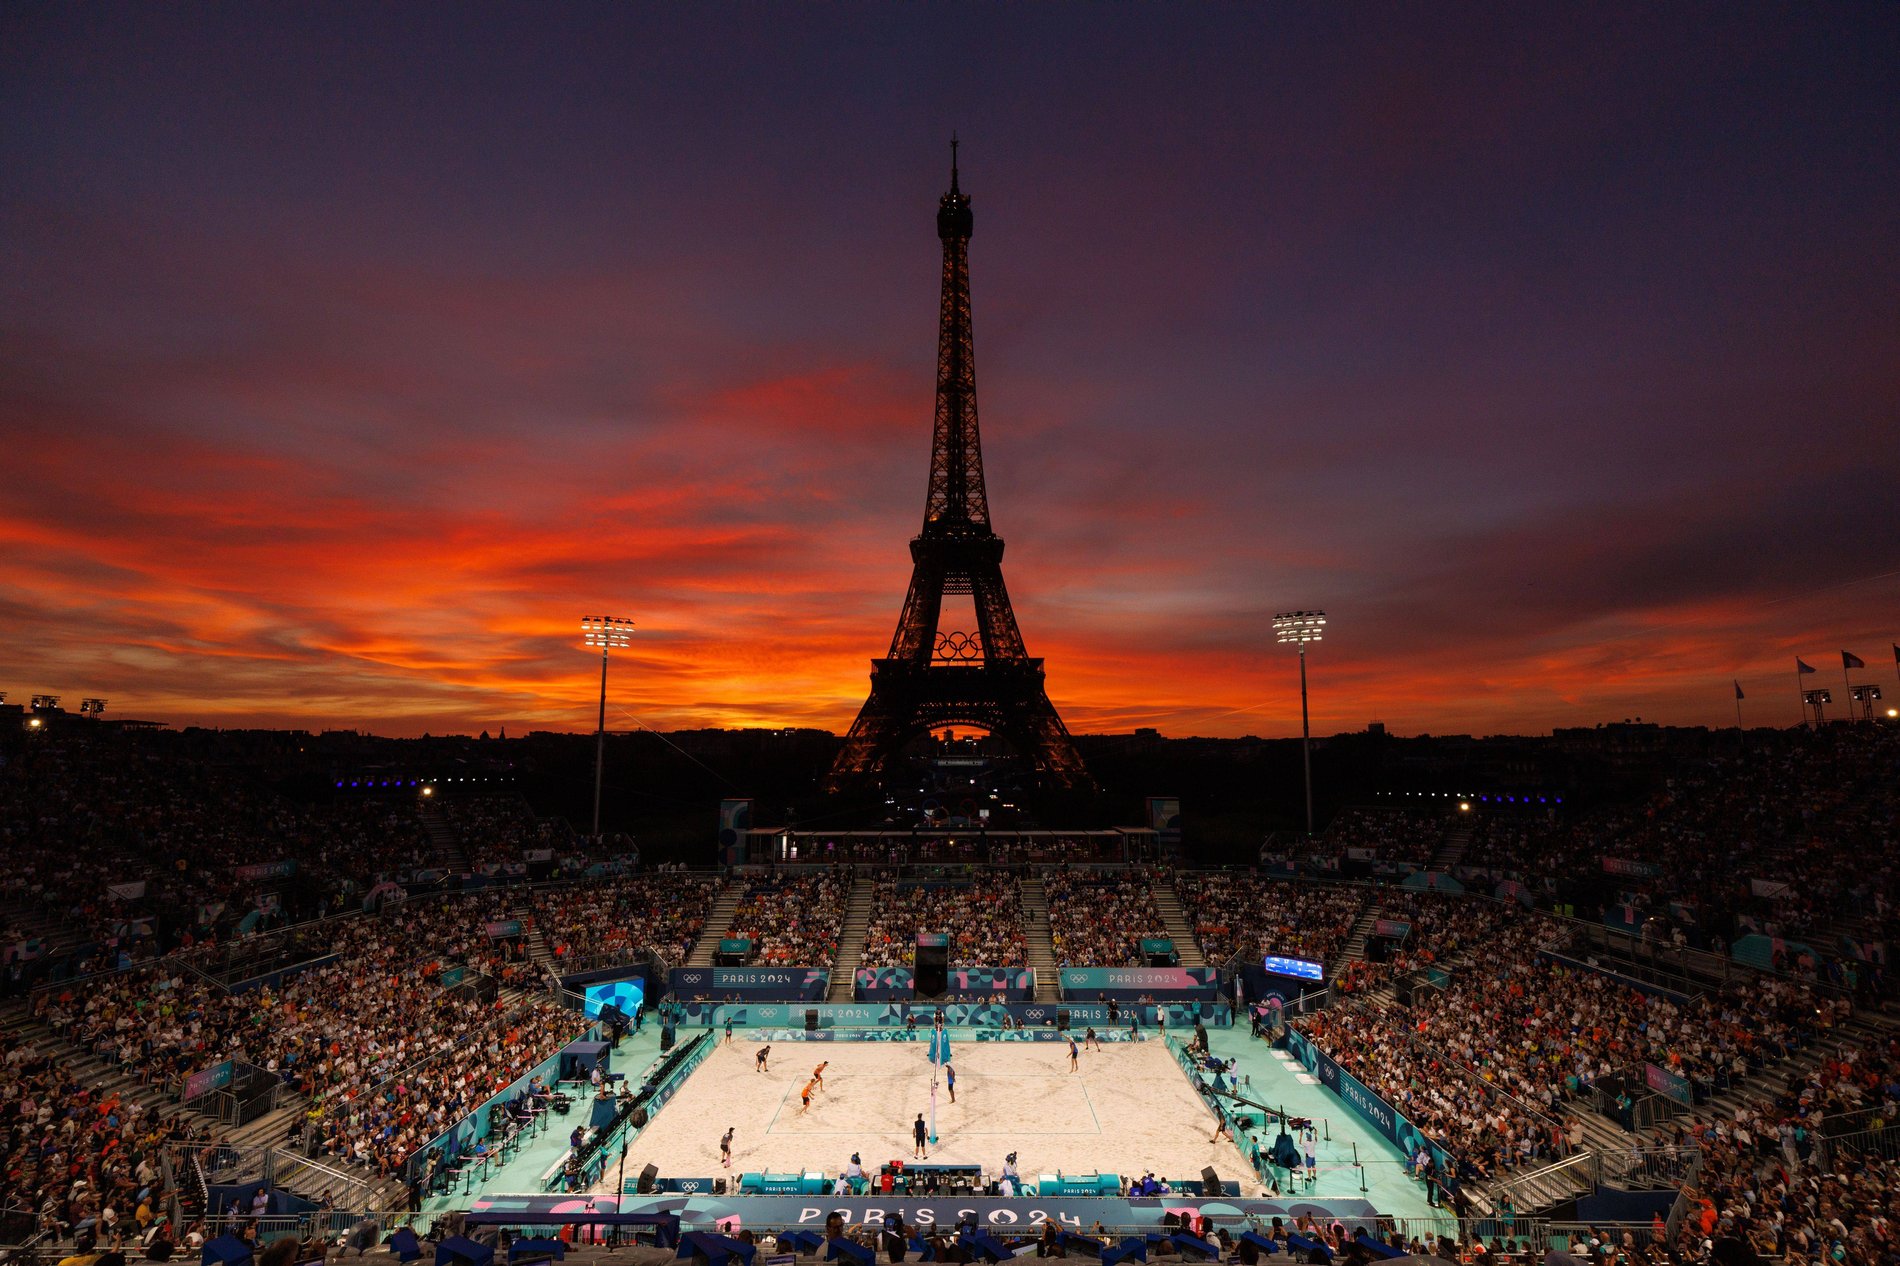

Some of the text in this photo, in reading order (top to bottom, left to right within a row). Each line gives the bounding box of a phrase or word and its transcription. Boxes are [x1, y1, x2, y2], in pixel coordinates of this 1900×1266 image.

[722, 974, 791, 983] PARIS 2024
[1109, 974, 1178, 984] PARIS 2024
[838, 1009, 869, 1018] 2024
[1345, 1082, 1390, 1130] PARIS 2024
